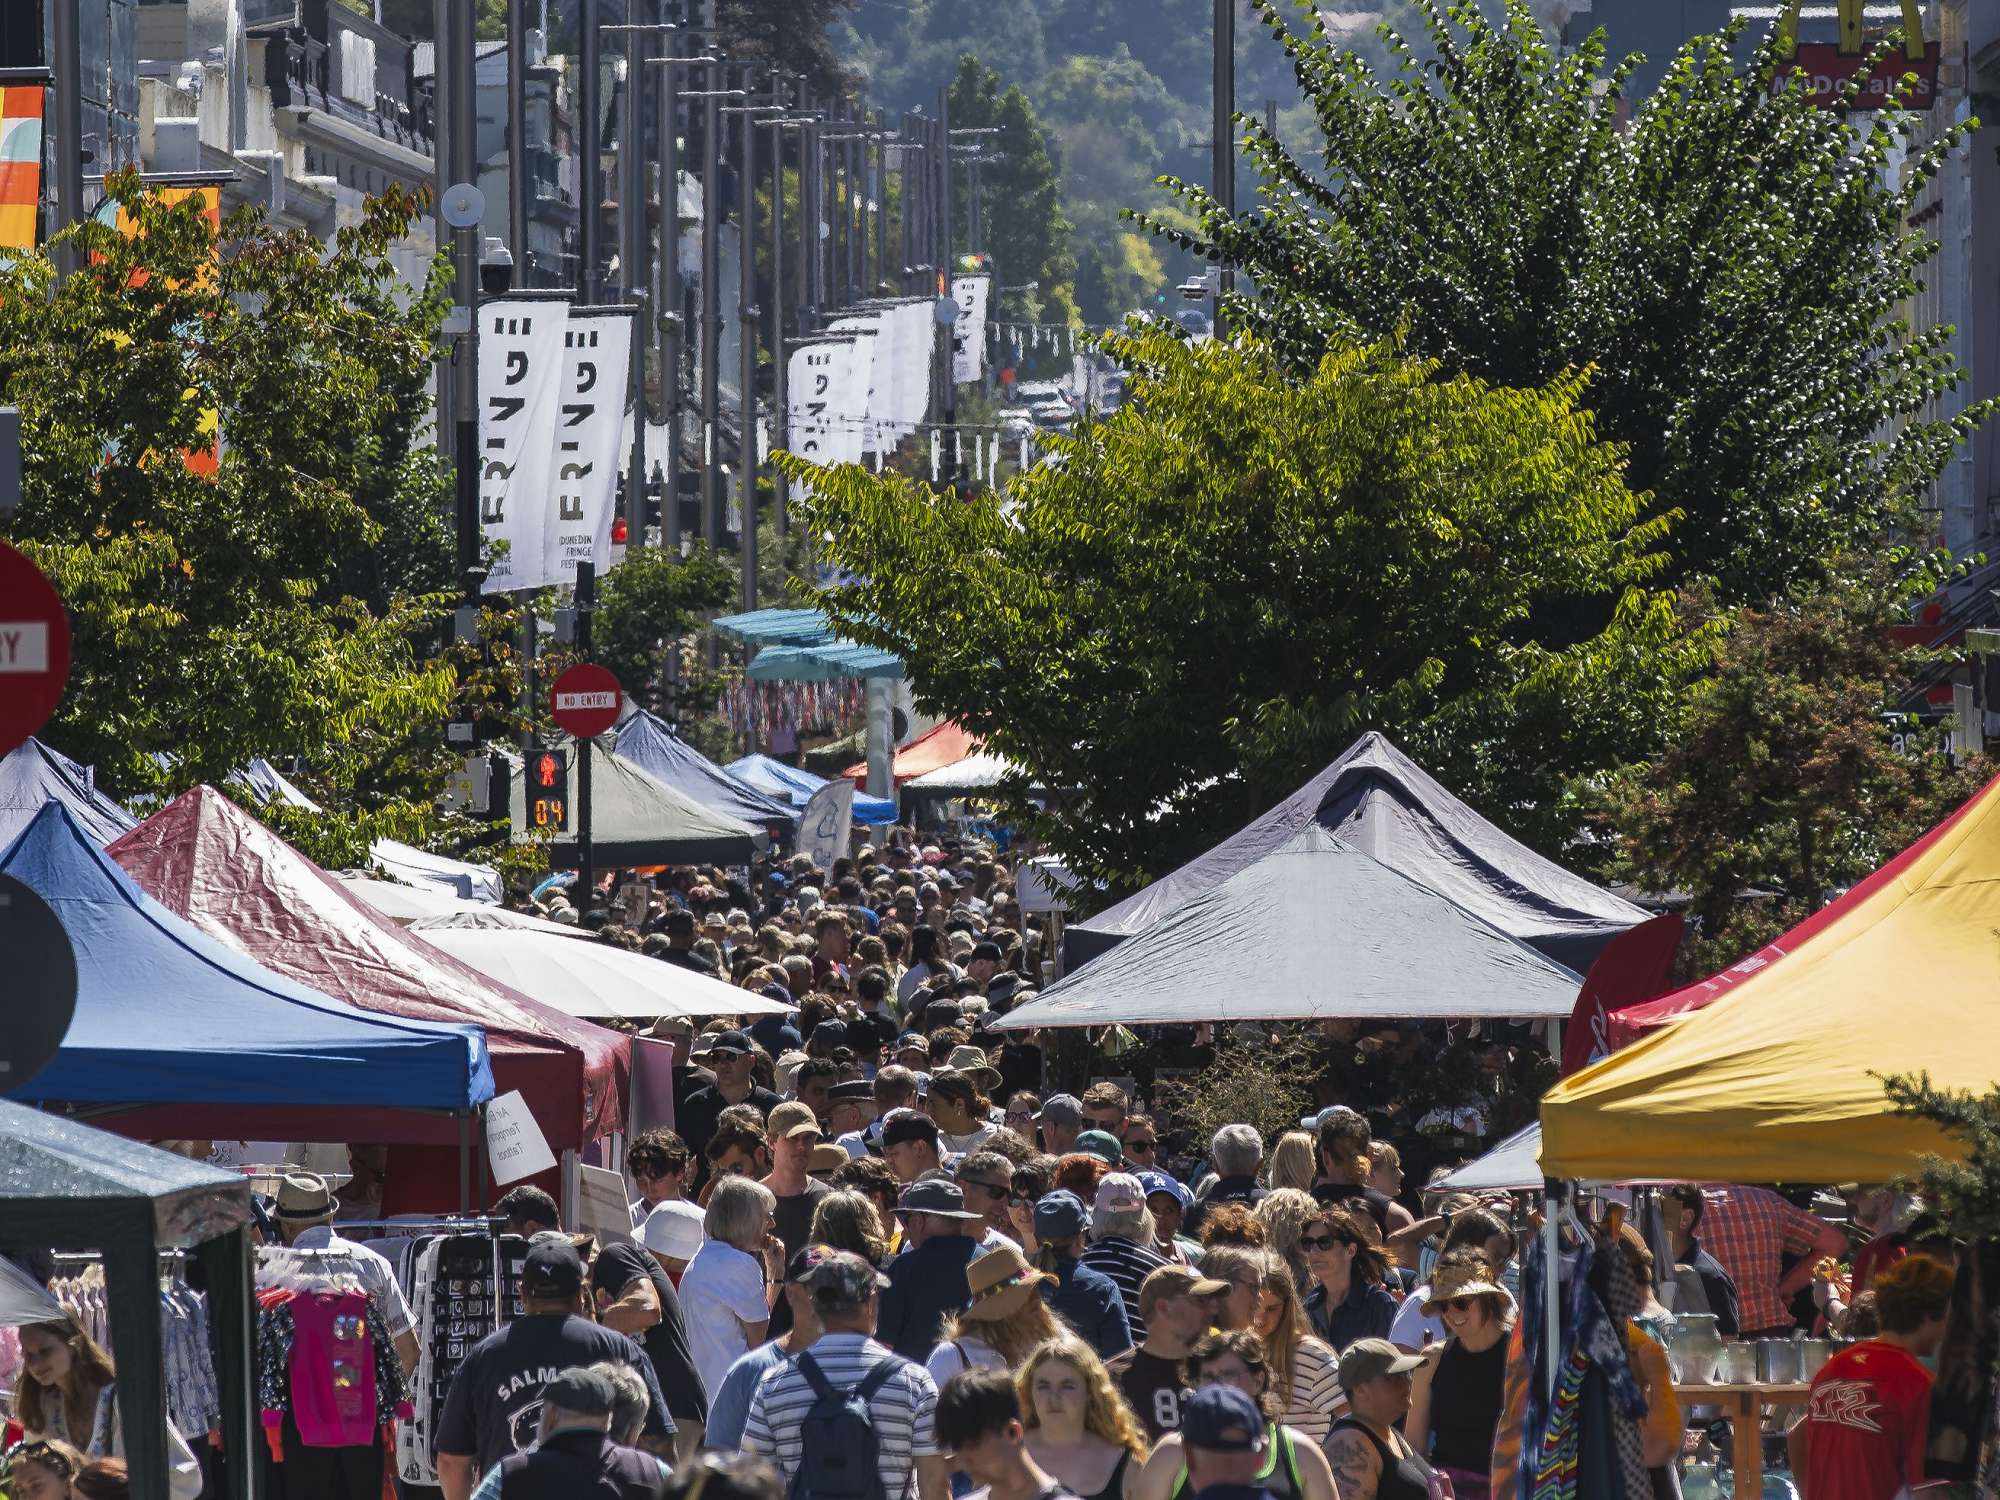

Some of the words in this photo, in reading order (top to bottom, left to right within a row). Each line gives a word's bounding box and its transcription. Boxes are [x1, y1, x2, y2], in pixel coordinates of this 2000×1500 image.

[1772, 75, 1930, 96] MDoals
[559, 330, 599, 521] FRINGE
[559, 535, 592, 546] DUNEDIN
[566, 546, 592, 557] FRINGE
[0, 631, 21, 664] Y
[564, 695, 576, 706] NO
[580, 694, 608, 706] ENTRY
[535, 799, 564, 826] 04
[497, 1367, 557, 1402] SALM
[1154, 1388, 1188, 1428] 8
